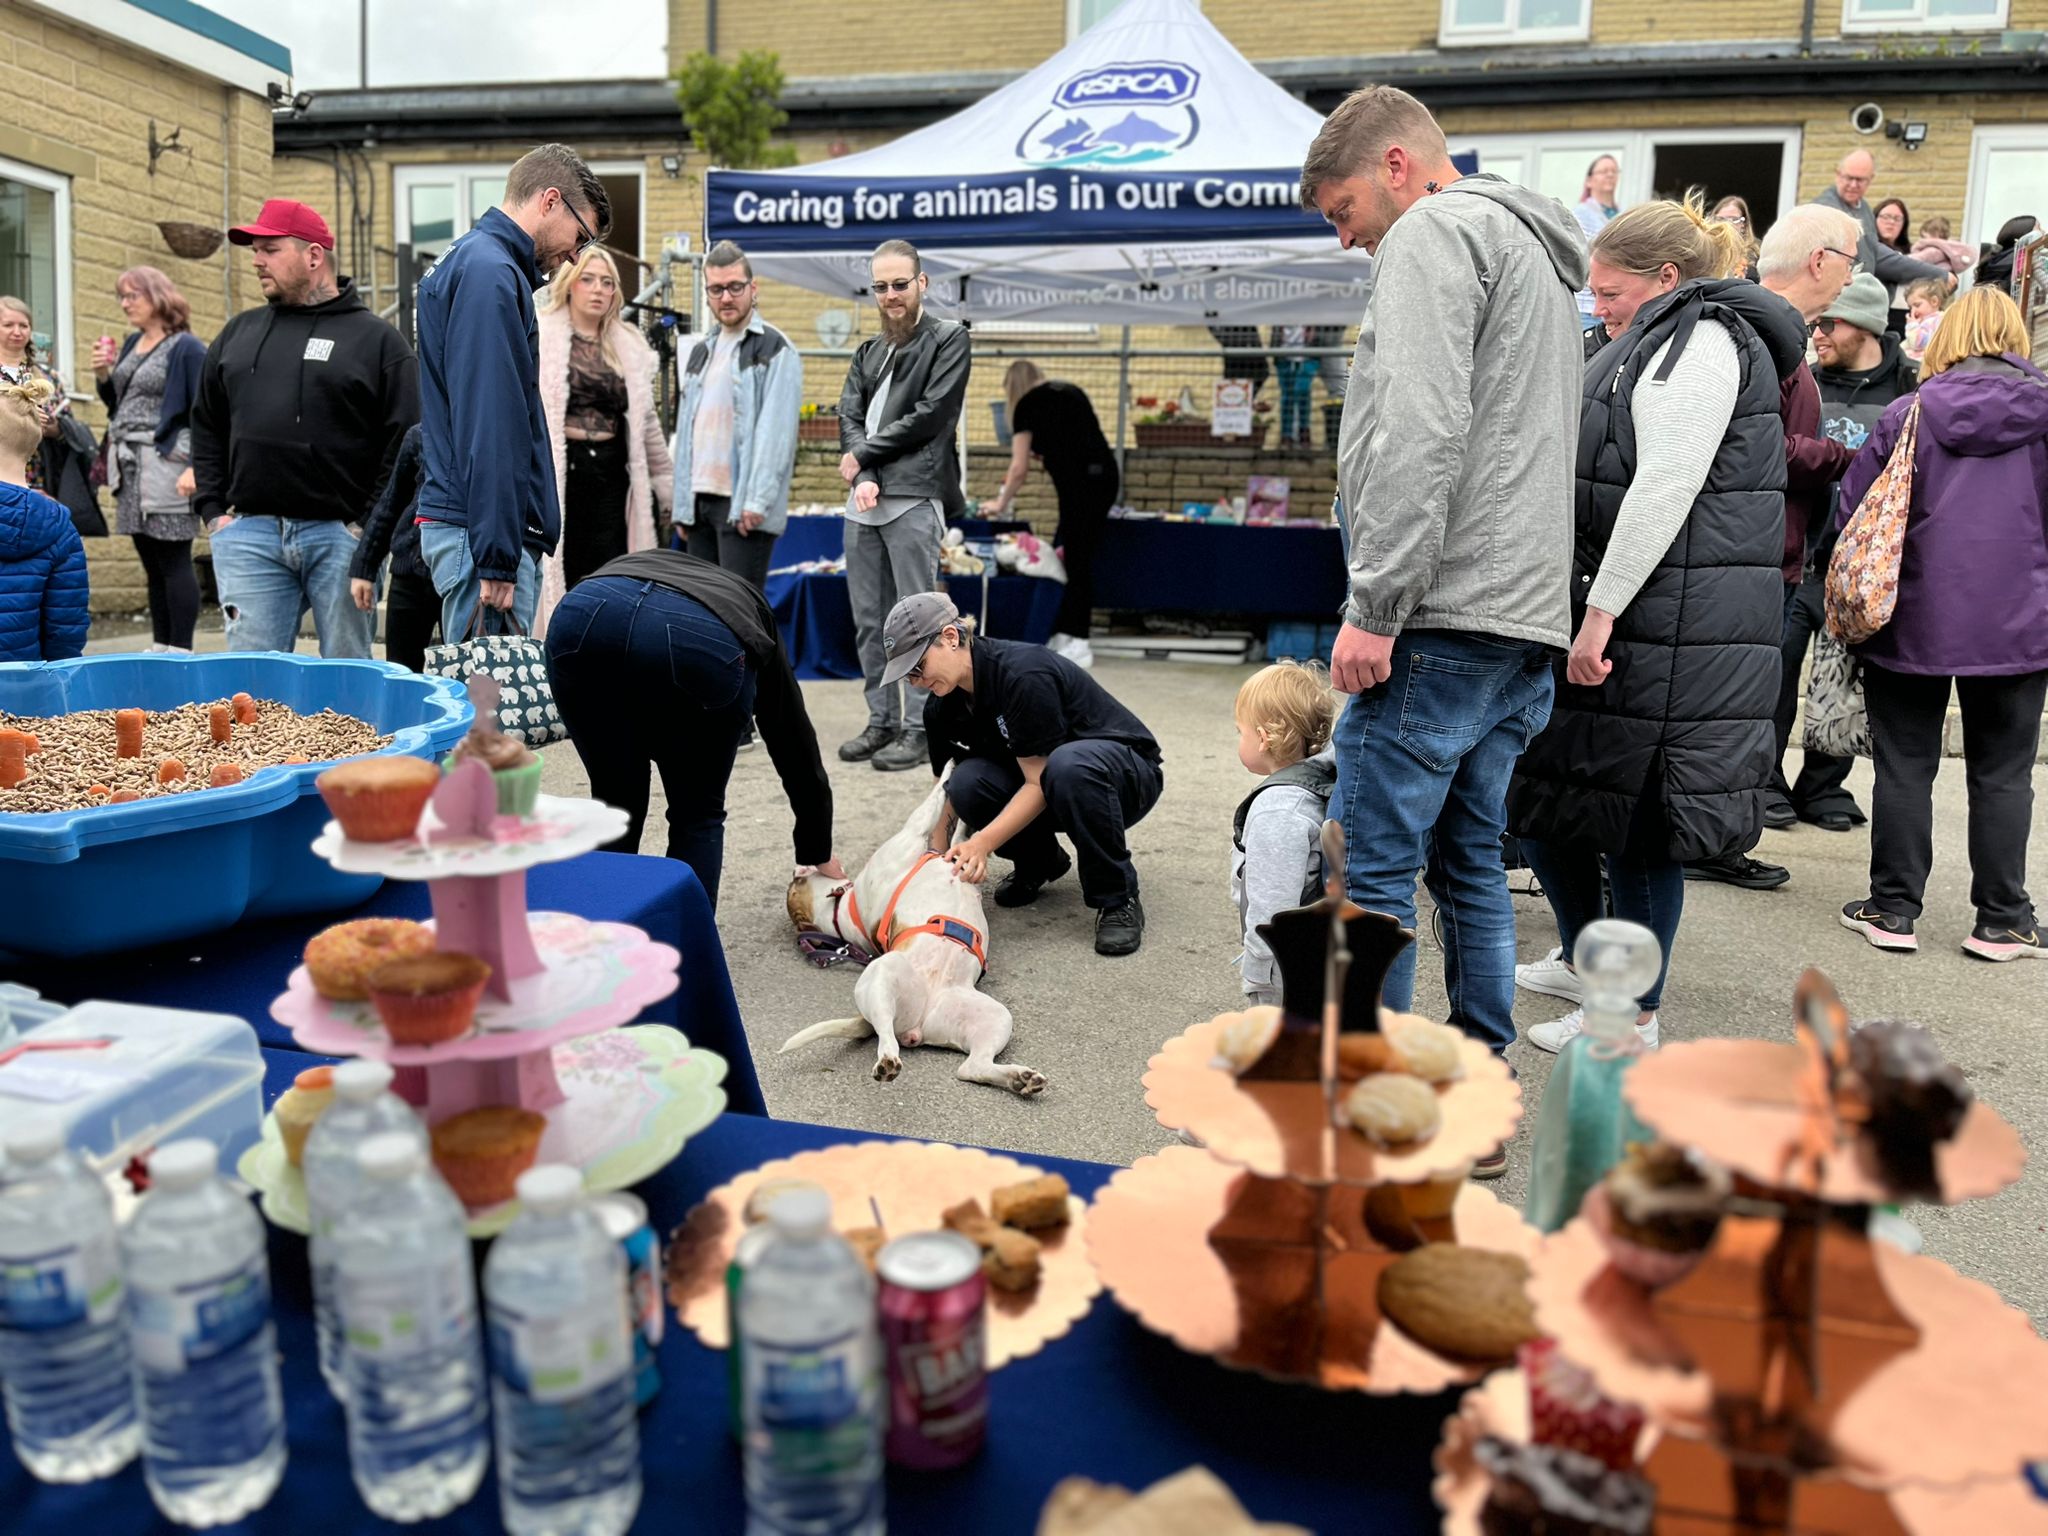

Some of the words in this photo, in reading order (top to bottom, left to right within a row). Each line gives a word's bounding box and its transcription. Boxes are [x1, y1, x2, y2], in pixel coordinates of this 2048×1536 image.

[1072, 72, 1177, 99] RSPCA
[733, 189, 845, 229] Caring
[852, 186, 904, 220] for
[912, 177, 1058, 218] animals
[1069, 174, 1105, 210] in
[1116, 180, 1184, 210] our
